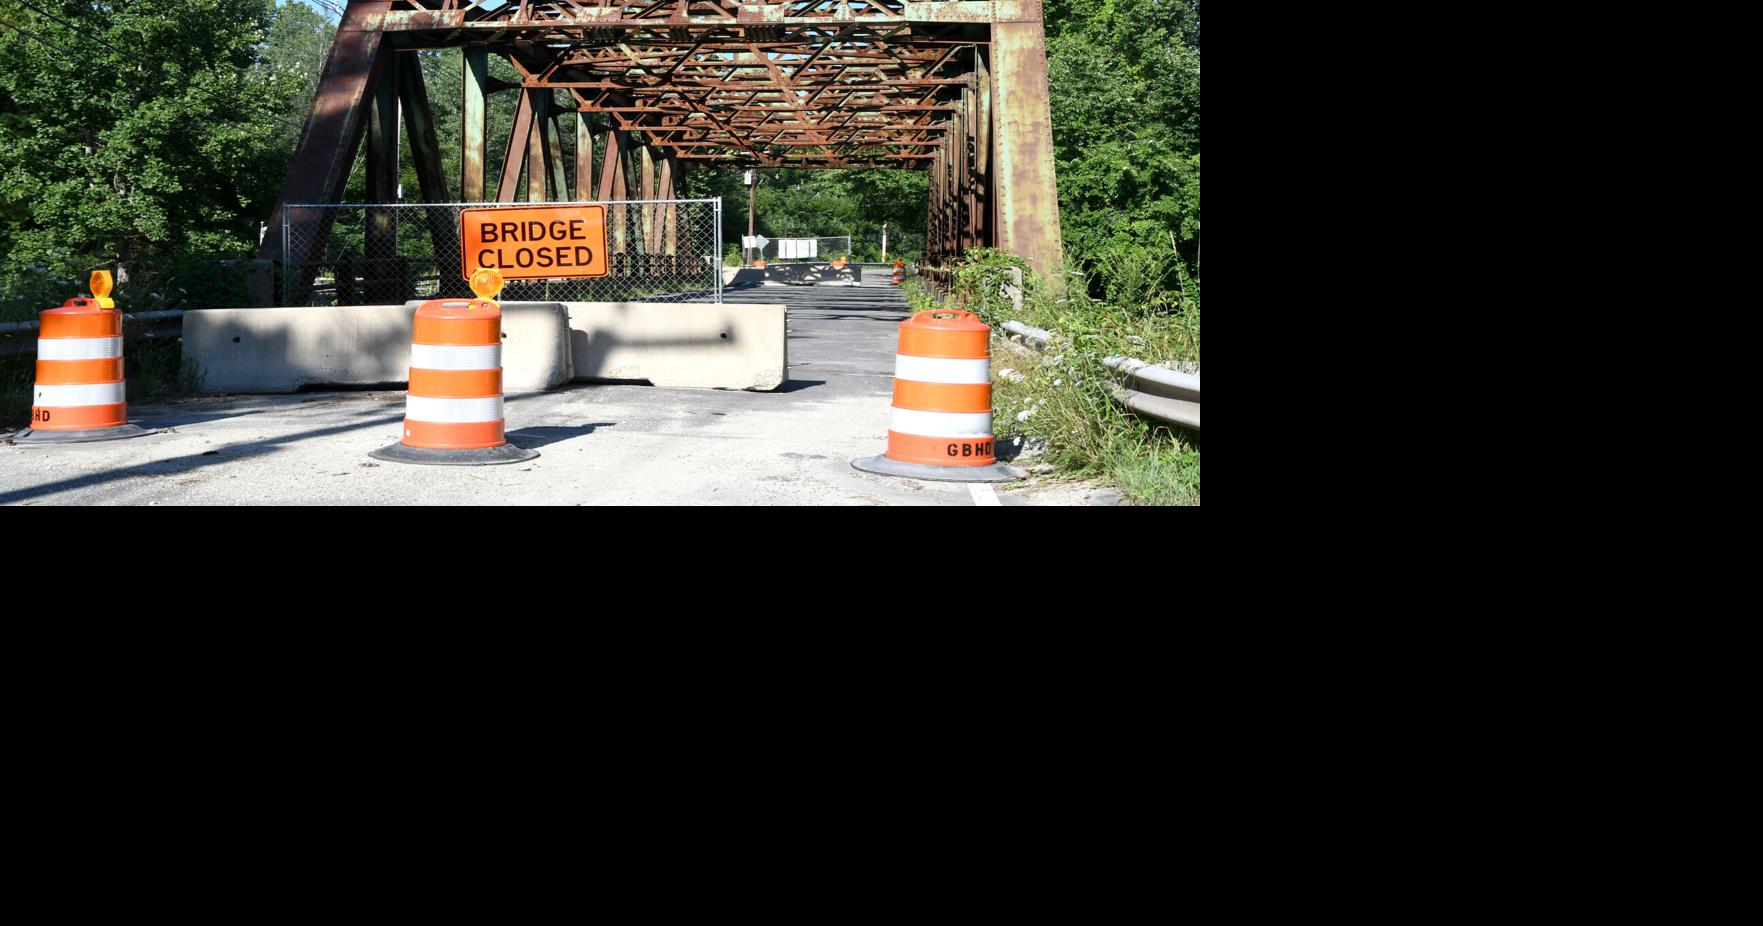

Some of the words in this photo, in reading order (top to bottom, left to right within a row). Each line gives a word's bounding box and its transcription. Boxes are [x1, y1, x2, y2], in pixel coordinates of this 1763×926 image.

[481, 220, 586, 243] BRIDGE
[478, 246, 593, 269] CLOSED
[947, 442, 991, 456] GBHD
